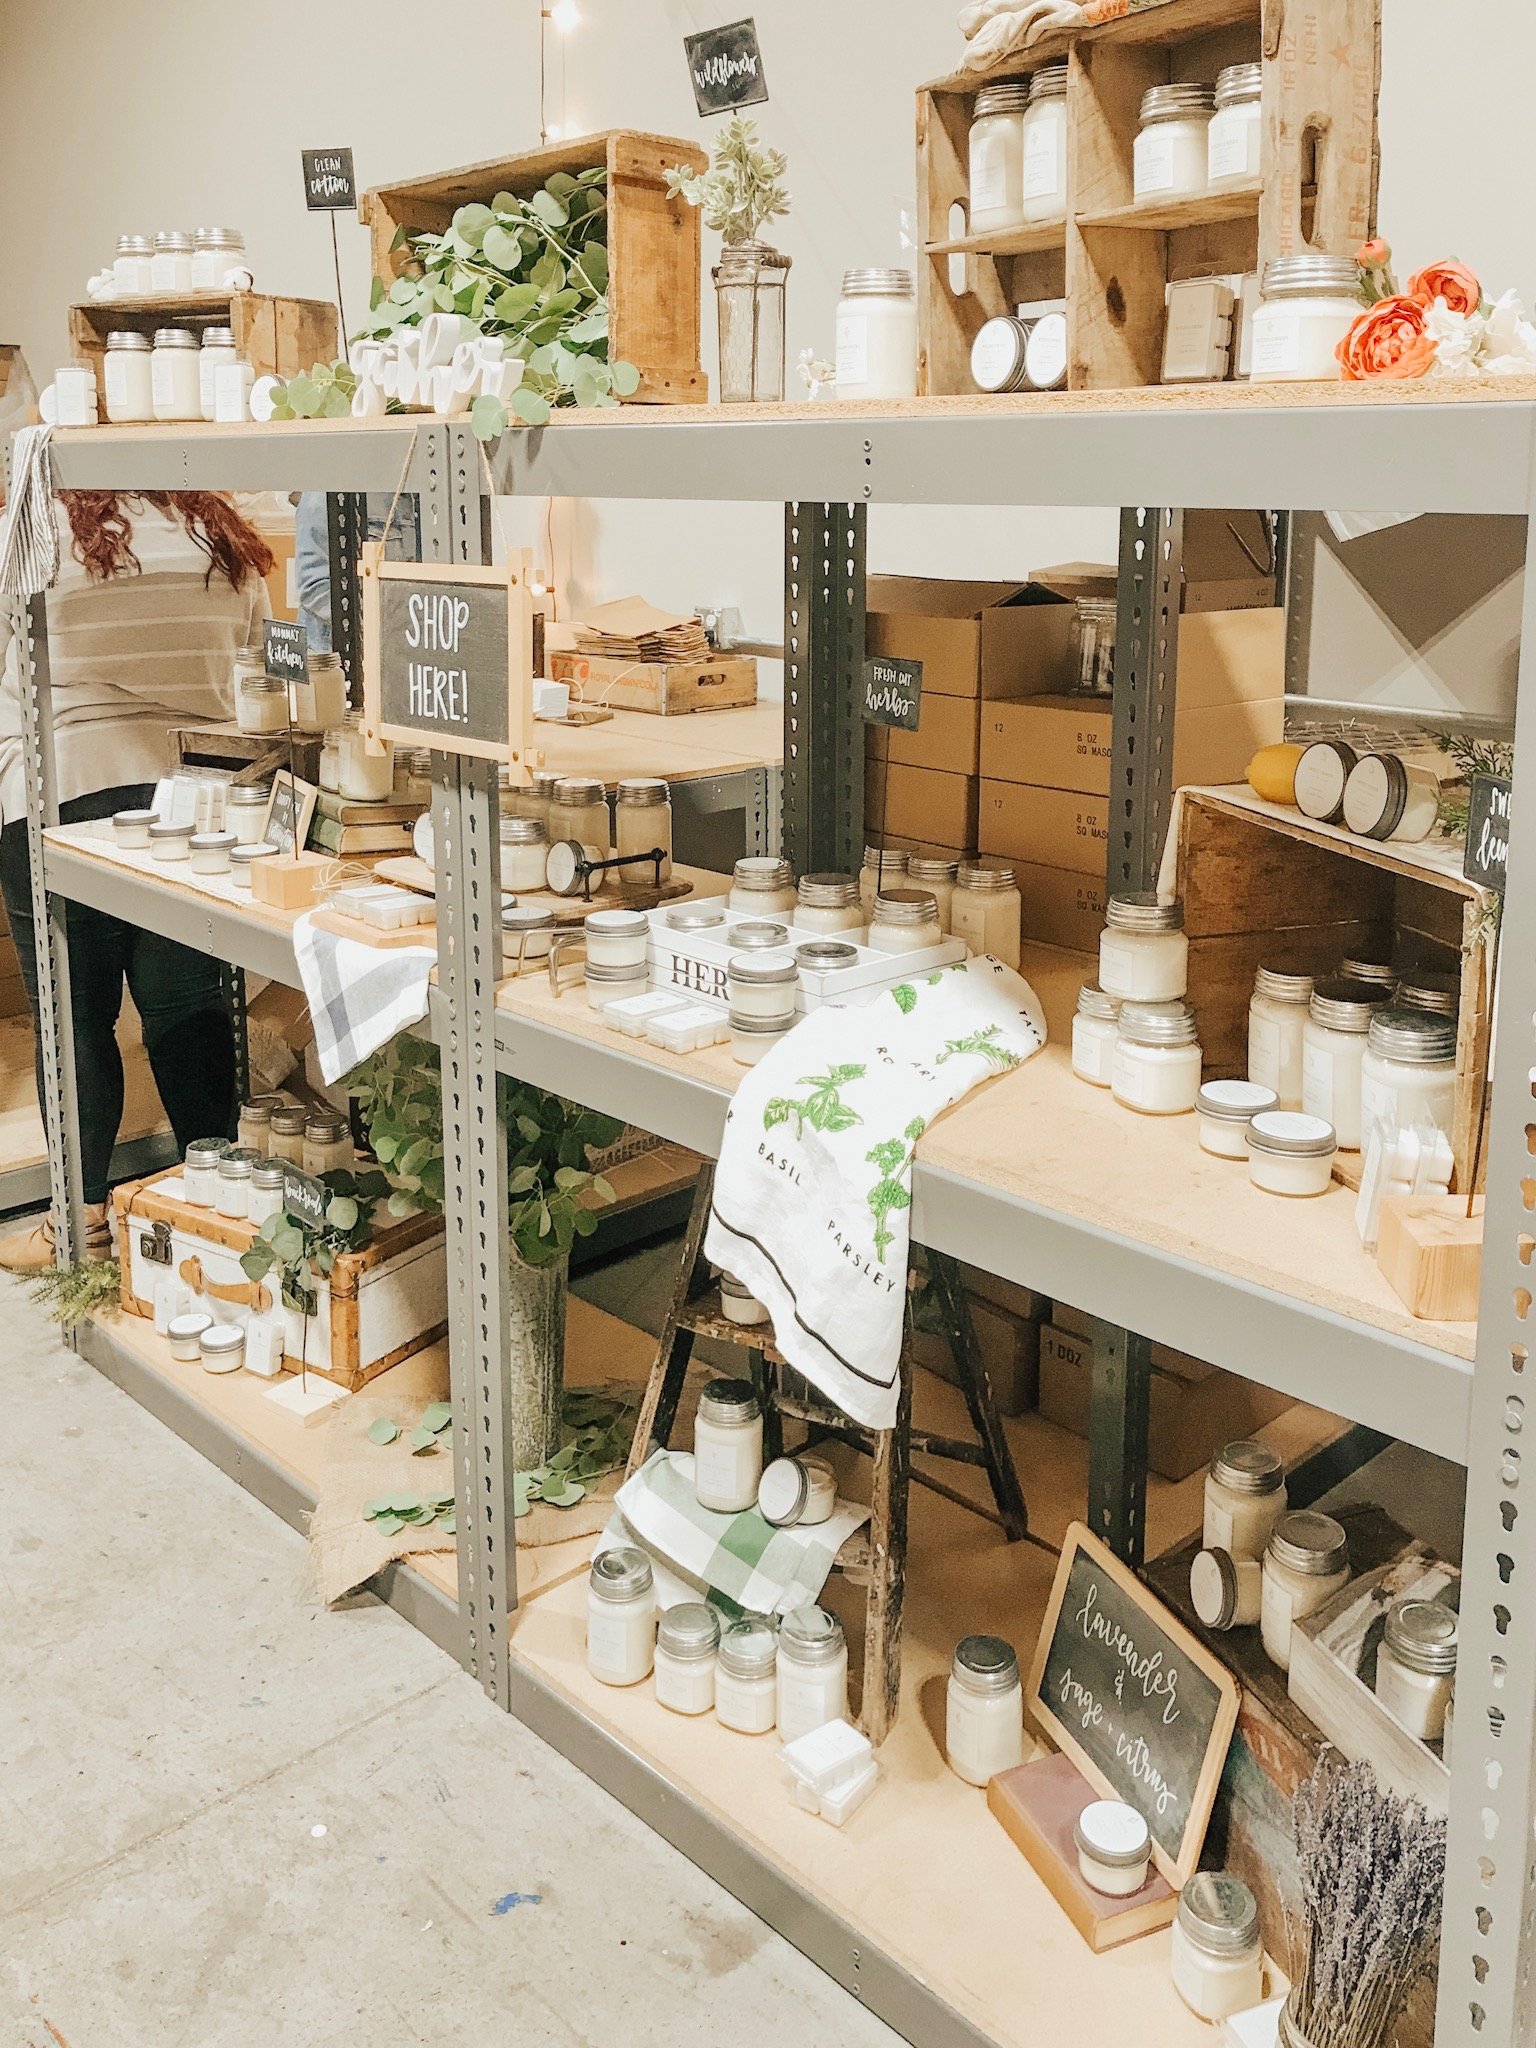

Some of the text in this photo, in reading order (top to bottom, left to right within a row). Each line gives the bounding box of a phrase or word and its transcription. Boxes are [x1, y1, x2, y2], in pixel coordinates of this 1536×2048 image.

[314, 156, 341, 173] CLEAN
[310, 174, 350, 198] cotton
[405, 593, 470, 653] SHOP
[267, 639, 304, 670] kitchen
[873, 665, 897, 683] FRESH
[408, 662, 469, 724] HERE!
[865, 683, 916, 717] herbs
[994, 723, 1004, 733] 12
[1087, 733, 1097, 744] OZ
[1076, 745, 1087, 755] SQ
[994, 799, 1003, 809] 12
[1490, 787, 1512, 820] SWE
[1076, 814, 1097, 825] 8 OZ
[1076, 826, 1108, 840] SQ MAS
[758, 1141, 801, 1187] BASIL
[827, 1219, 897, 1294] PARSLEY
[1057, 1344, 1082, 1368] DOZ
[1075, 1583, 1181, 1725] lavender
[1059, 1667, 1104, 1729] sage
[1116, 1731, 1178, 1815] citrus
